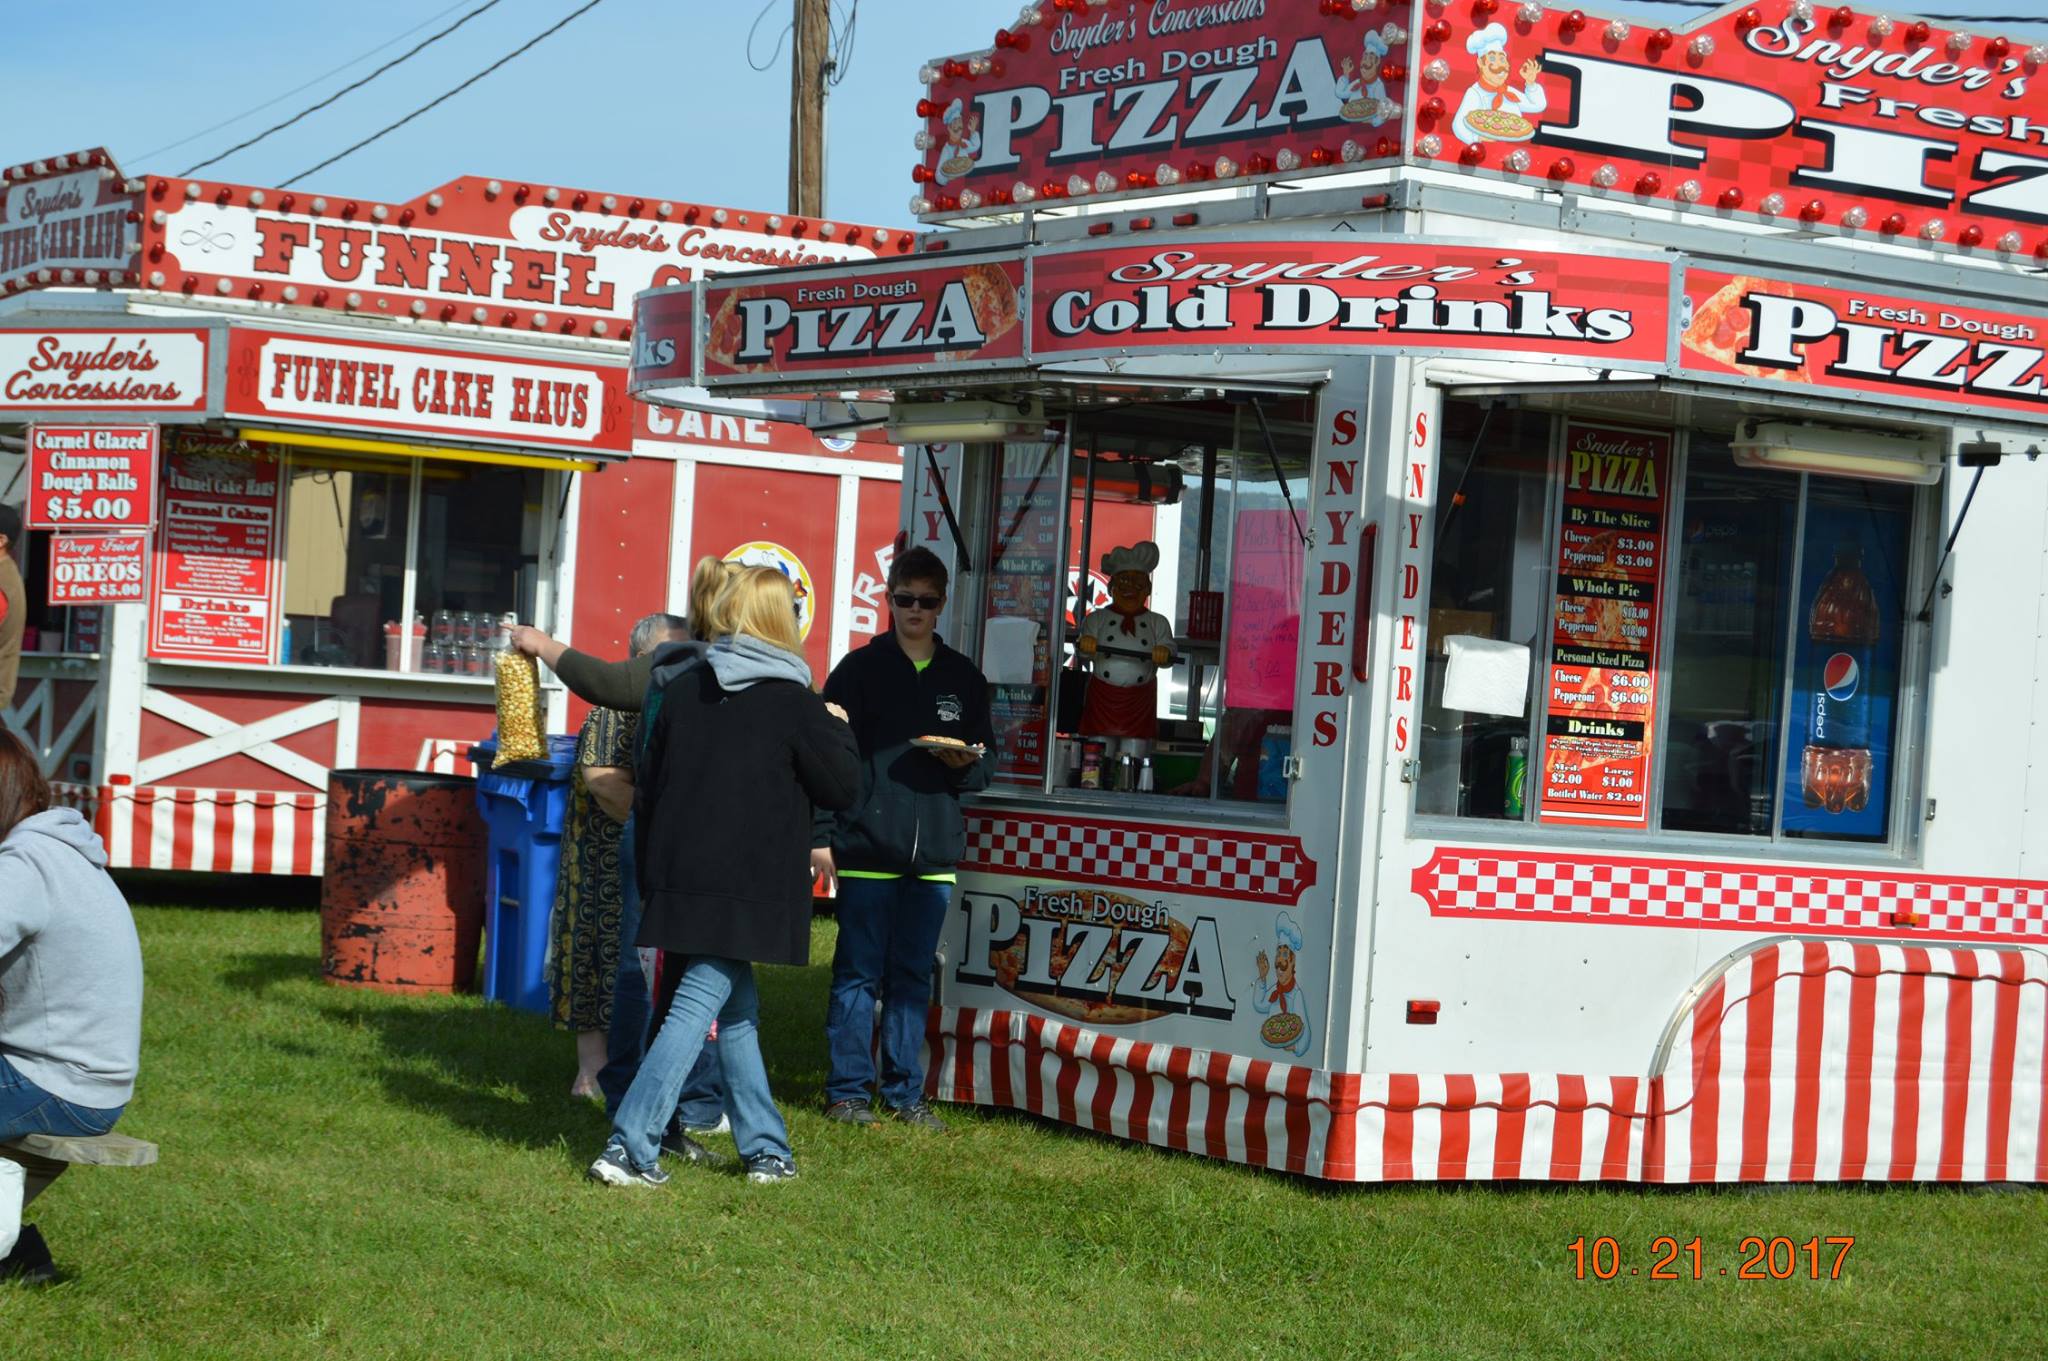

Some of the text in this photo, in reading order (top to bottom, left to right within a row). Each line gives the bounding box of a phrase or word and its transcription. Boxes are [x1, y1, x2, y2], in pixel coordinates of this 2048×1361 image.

[1050, 0, 1267, 59] Snyder's Concessions
[1059, 36, 1278, 90] Fresh Dough
[1745, 15, 2029, 98] Snyder's
[973, 37, 1345, 171] PIZZA
[1821, 81, 2048, 145] Fresh
[20, 180, 83, 224] Snyder's
[539, 212, 671, 253] Snyder's
[253, 217, 614, 311] FUNNEL
[1111, 249, 1538, 288] Snyder's
[797, 280, 917, 304] Fresh Dough
[738, 281, 986, 358] PIZZA
[1051, 283, 1635, 342] Cold Drinks
[1848, 299, 2037, 341] Fresh Dough
[29, 336, 159, 382] Snyder's
[1742, 293, 2048, 397] PIZZ
[5, 370, 181, 401] Concessions
[271, 353, 589, 429] FUNNEL CAKE HAUS
[36, 431, 148, 450] Carmel Glazed
[1576, 432, 1655, 458] Snyder's
[50, 452, 130, 471] Cinnamon
[1002, 443, 1059, 479] PIZZA
[1568, 451, 1658, 498] PIZZA
[42, 472, 138, 495] Dough Balls
[47, 496, 131, 521] $5.00
[1571, 508, 1651, 529] By The Slice
[1564, 529, 1654, 551] Cheese $3.00
[1002, 560, 1045, 573] Whole Pie
[1563, 549, 1653, 567] Pepperoni $3.00
[55, 562, 142, 583] OREOS
[1312, 409, 1359, 747] SNYDERS
[1395, 411, 1427, 752] SNYDERS
[56, 583, 141, 597] 5 for $5.00
[1572, 578, 1640, 598] Whole Pie
[1560, 600, 1649, 620] Cheese $18.00
[1558, 619, 1598, 634] Pepperoni
[1556, 648, 1645, 669] Personal Sized Pizza
[1554, 669, 1649, 688] Cheese $6.00
[996, 687, 1033, 702] Drinks
[1554, 687, 1648, 704] Pepperoni $6.00
[1568, 719, 1625, 737] Drinks
[1815, 692, 1826, 739] pepsi
[1551, 773, 1582, 785] $2.00
[1554, 763, 1635, 776] Med. Large
[1547, 787, 1643, 802] Bottled Water $2.00
[1025, 886, 1170, 927] Fresh Dough
[957, 892, 1237, 1012] PIZZA
